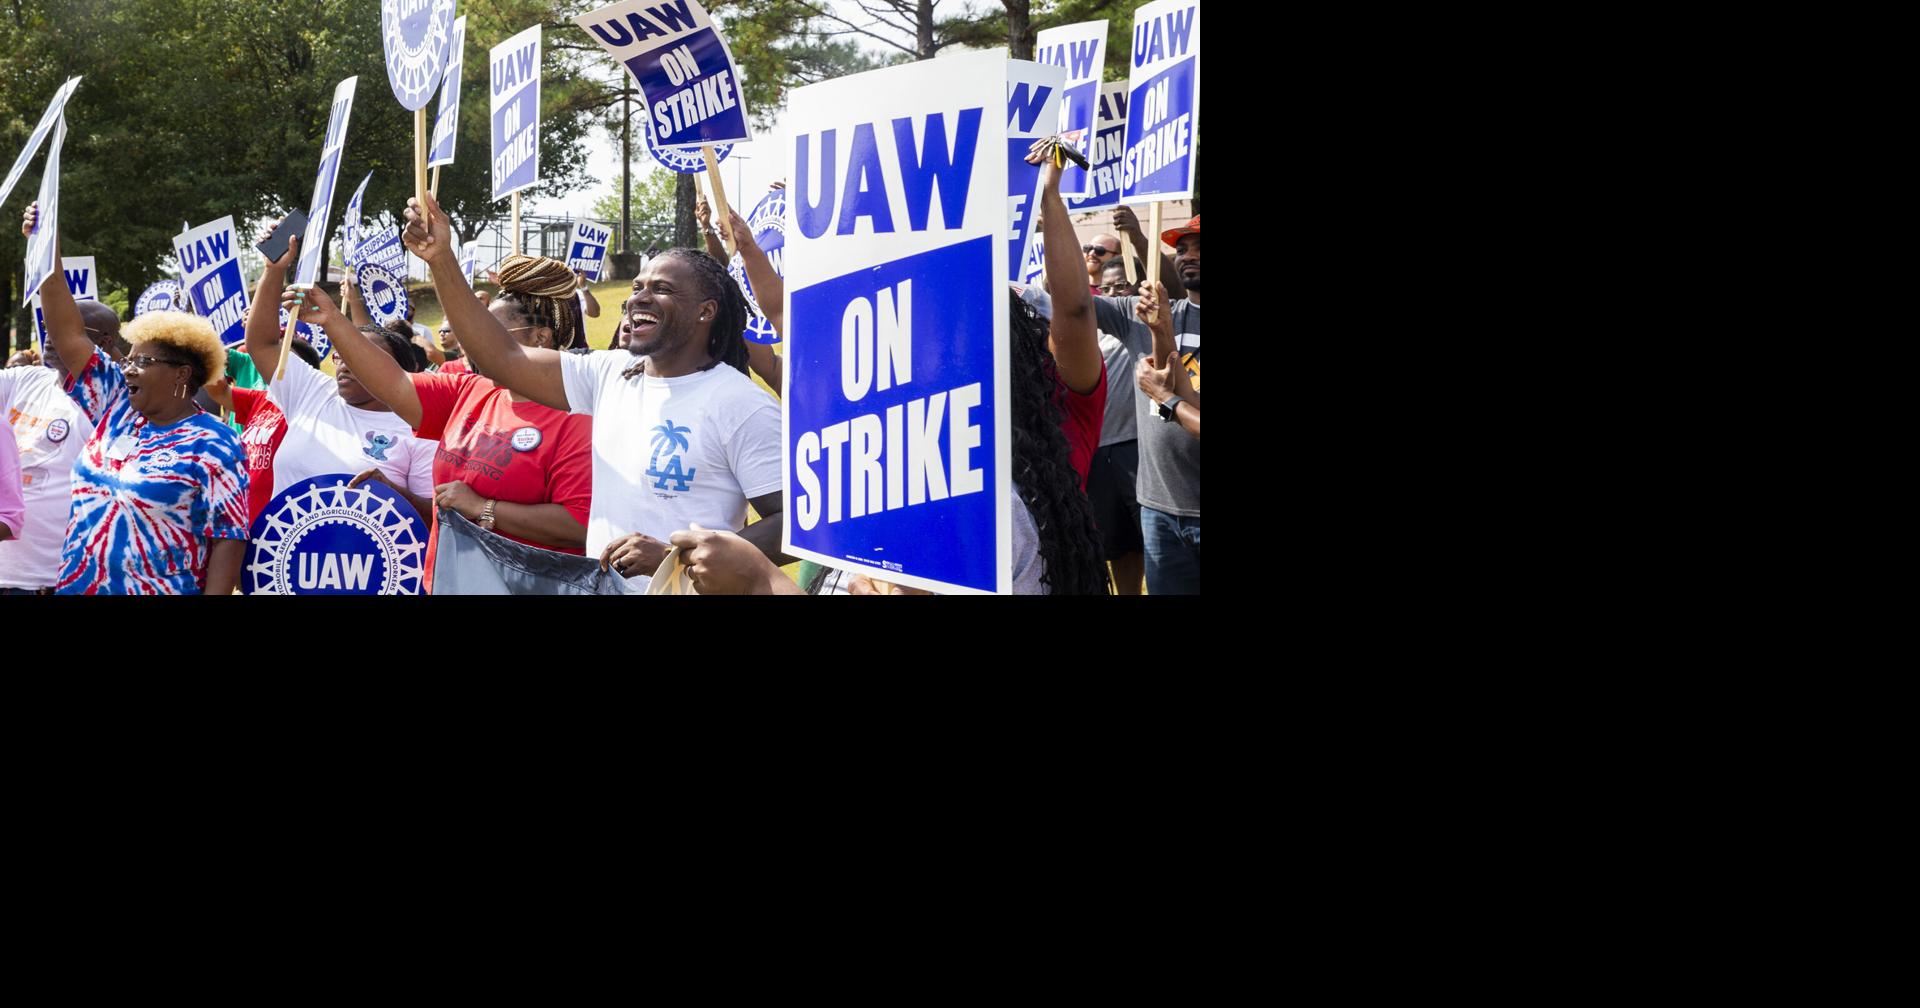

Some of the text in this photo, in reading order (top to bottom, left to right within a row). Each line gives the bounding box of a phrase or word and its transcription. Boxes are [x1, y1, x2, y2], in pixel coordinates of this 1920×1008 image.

[590, 0, 697, 46] UAW
[1134, 6, 1195, 68] UAW
[492, 42, 536, 96] UAW
[660, 44, 701, 87] ON
[504, 98, 520, 142] ON
[654, 70, 736, 139] STRIKE
[1143, 76, 1169, 132] ON
[494, 122, 534, 192] STRIKE
[1094, 130, 1122, 166] ON
[1124, 112, 1190, 190] STRIKE
[796, 107, 983, 240] UAW
[180, 230, 229, 274] UAW
[354, 228, 395, 262] WE SUPPORT
[579, 224, 608, 244] UAW
[582, 246, 596, 258] ON
[570, 258, 600, 272] STRIKE
[203, 273, 225, 310] ON
[208, 291, 244, 337] TRIKE
[841, 278, 912, 402] ON
[796, 382, 984, 532] STRIKE
[279, 522, 304, 554] AEROSPACE
[304, 512, 320, 523] AND
[321, 508, 370, 524] AGRICULTURAL
[370, 521, 395, 556] IMPLEMENT
[390, 557, 399, 591] WORKERS
[299, 552, 374, 590] UAW
